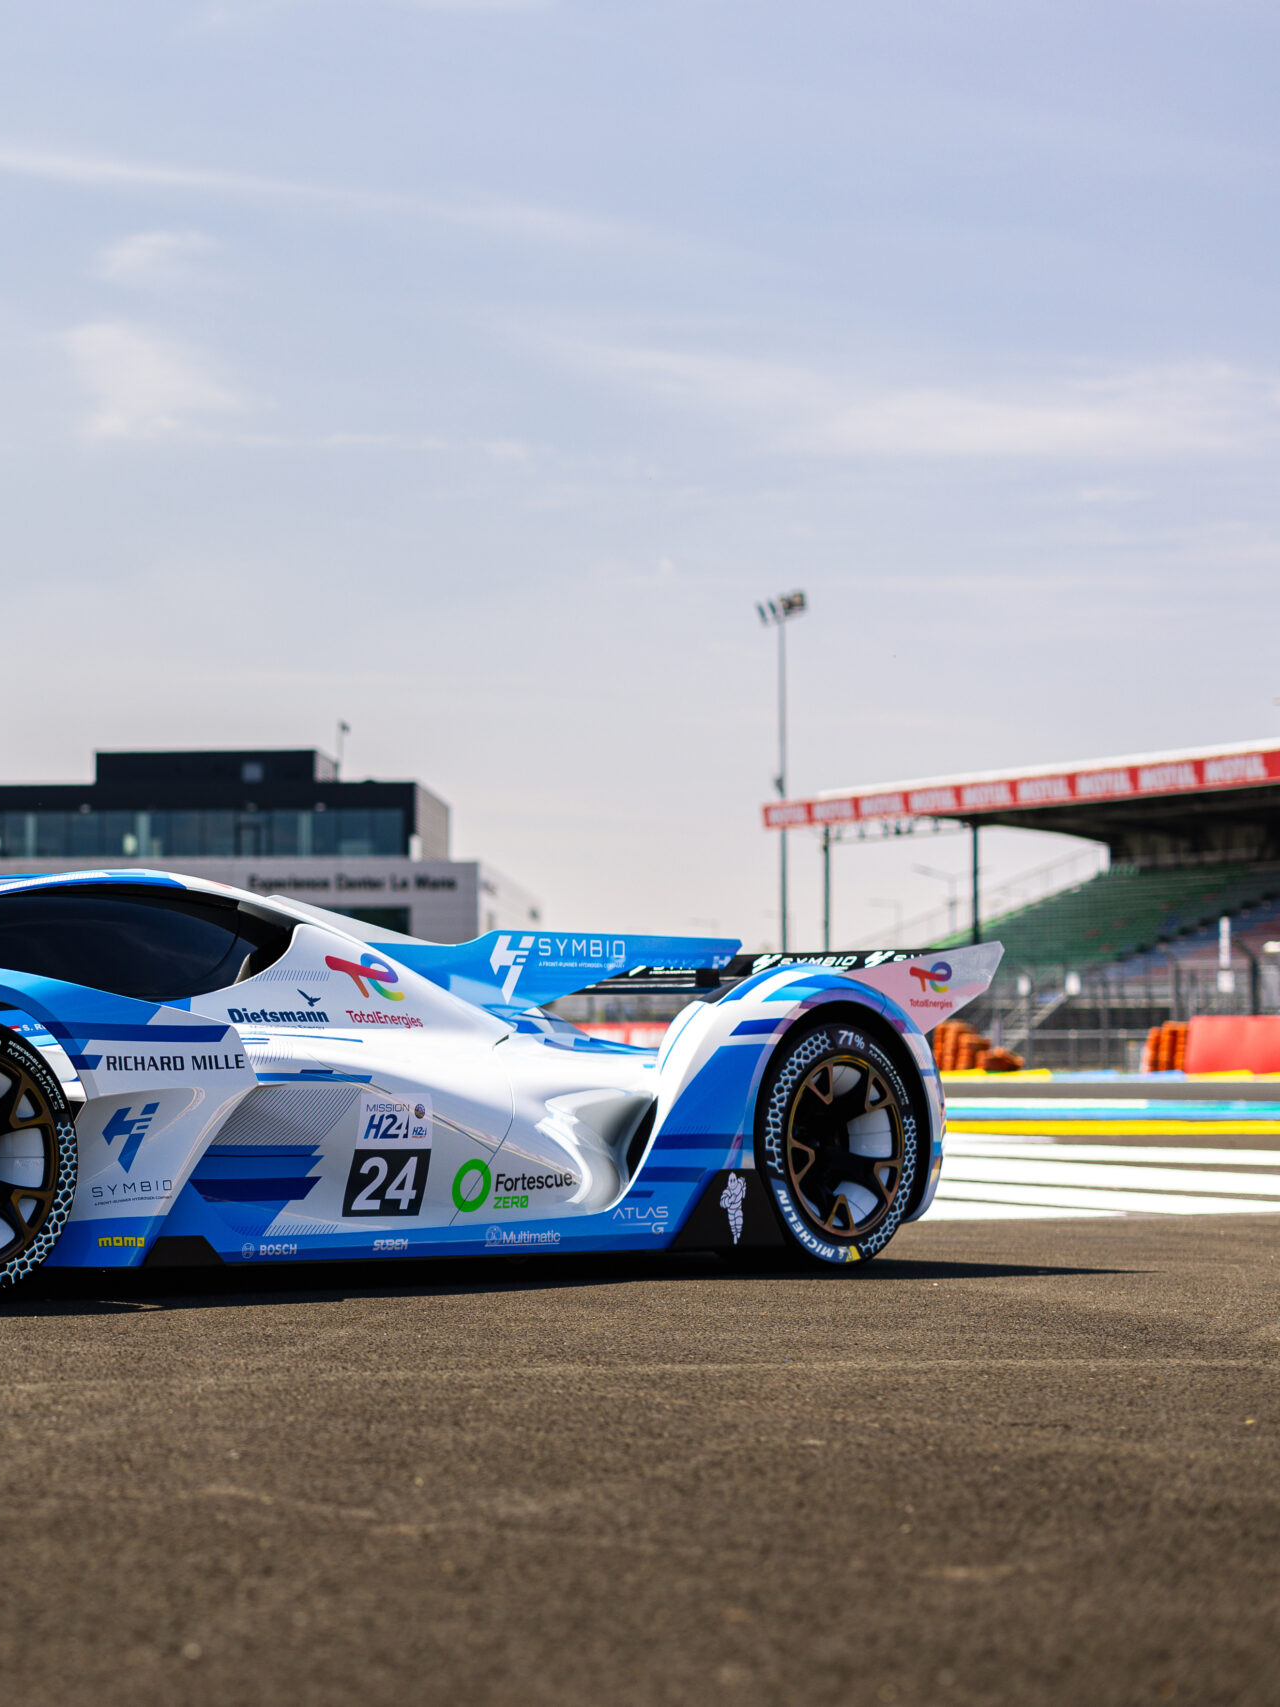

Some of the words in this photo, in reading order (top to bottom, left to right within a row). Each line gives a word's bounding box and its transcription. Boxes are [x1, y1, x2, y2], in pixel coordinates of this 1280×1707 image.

[248, 873, 331, 892] Experience
[335, 873, 385, 890] Center
[389, 873, 409, 889] Le
[414, 873, 458, 889] Mans
[538, 938, 626, 958] SYMBIO
[909, 998, 954, 1010] TotalEnergies
[227, 1007, 330, 1023] Dietsmann
[346, 1010, 424, 1029] TotalEnergies
[838, 1030, 865, 1049] 71%
[8, 1040, 43, 1071] RENEWABLE
[106, 1055, 185, 1071] RICHARD
[191, 1054, 245, 1070] MILLE
[7, 1048, 59, 1110] MATERIALS
[366, 1104, 410, 1112] MISSION
[364, 1113, 410, 1139] H24
[91, 1180, 173, 1198] SYMBIO
[351, 1156, 418, 1210] 24
[612, 1206, 668, 1220] ATLAS
[776, 1189, 835, 1258] MICHELIN
[502, 1230, 560, 1244] Multimatic
[259, 1244, 297, 1256] BOSCH
